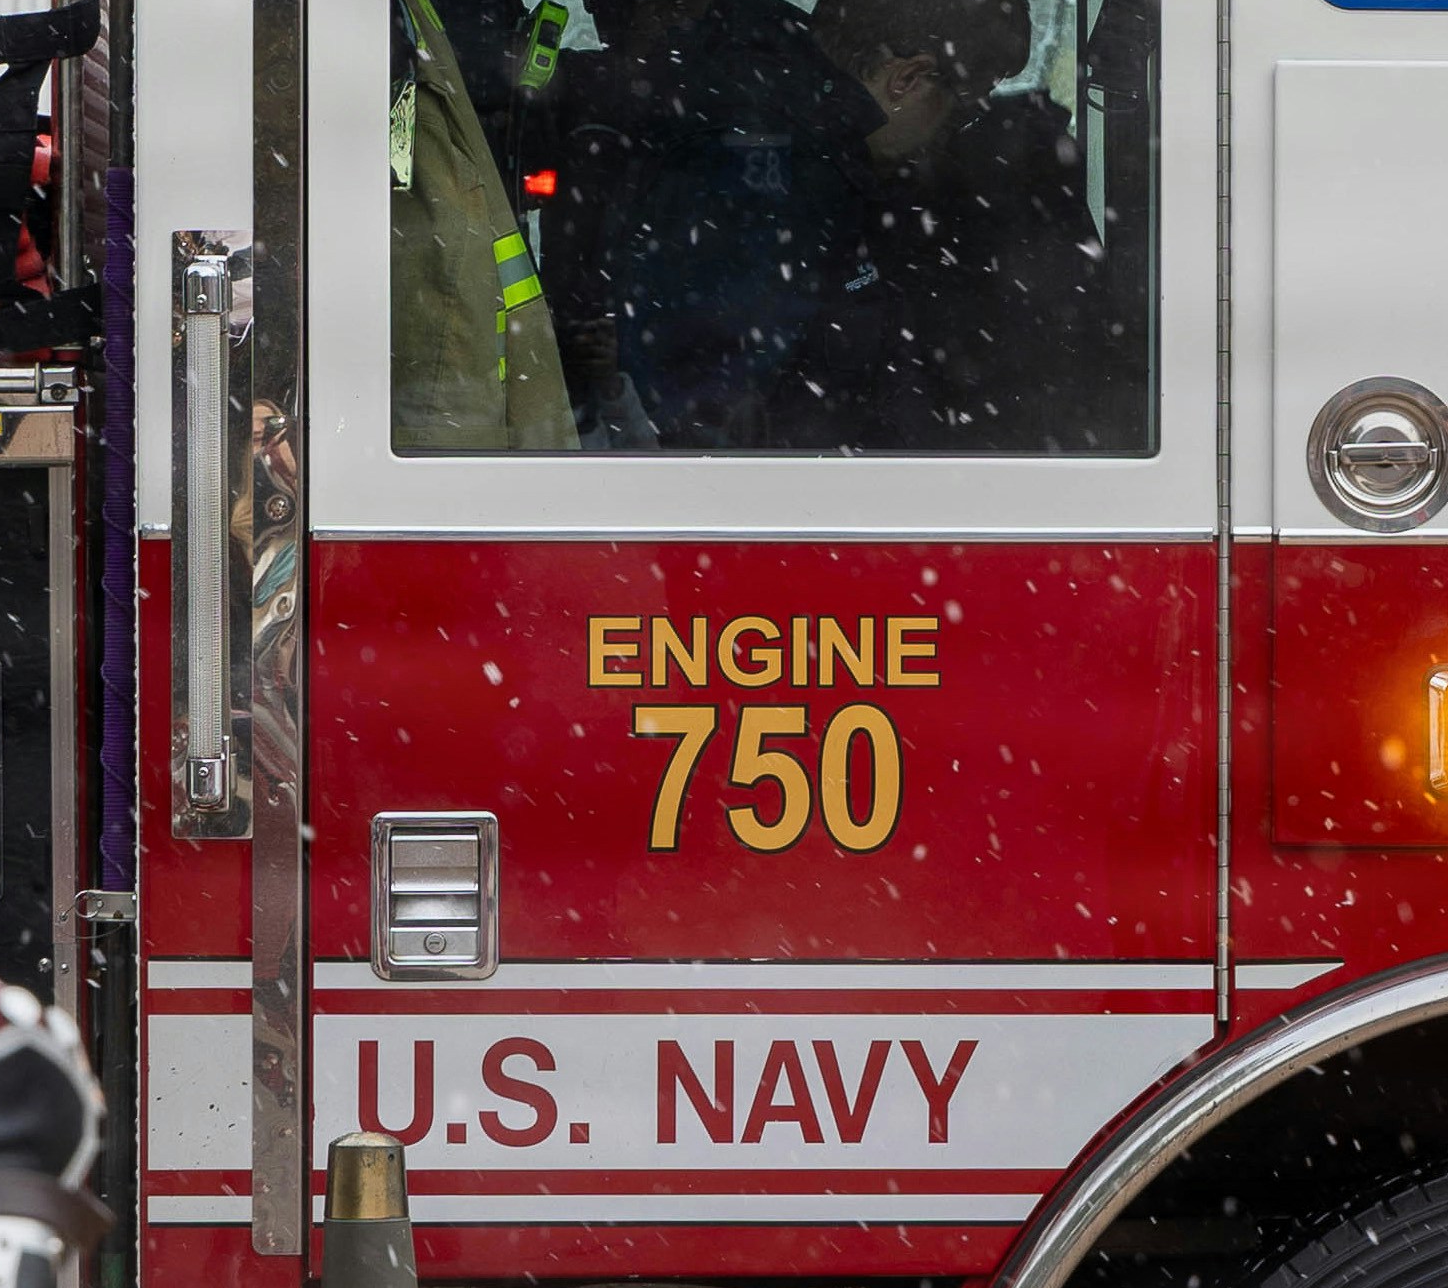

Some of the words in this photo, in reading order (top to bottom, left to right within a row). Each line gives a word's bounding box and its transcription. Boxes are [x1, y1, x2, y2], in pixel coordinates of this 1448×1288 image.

[586, 614, 942, 688] ENGINE
[631, 702, 904, 855] 750
[357, 1037, 590, 1148] U.S.
[655, 1039, 981, 1146] NAVY
